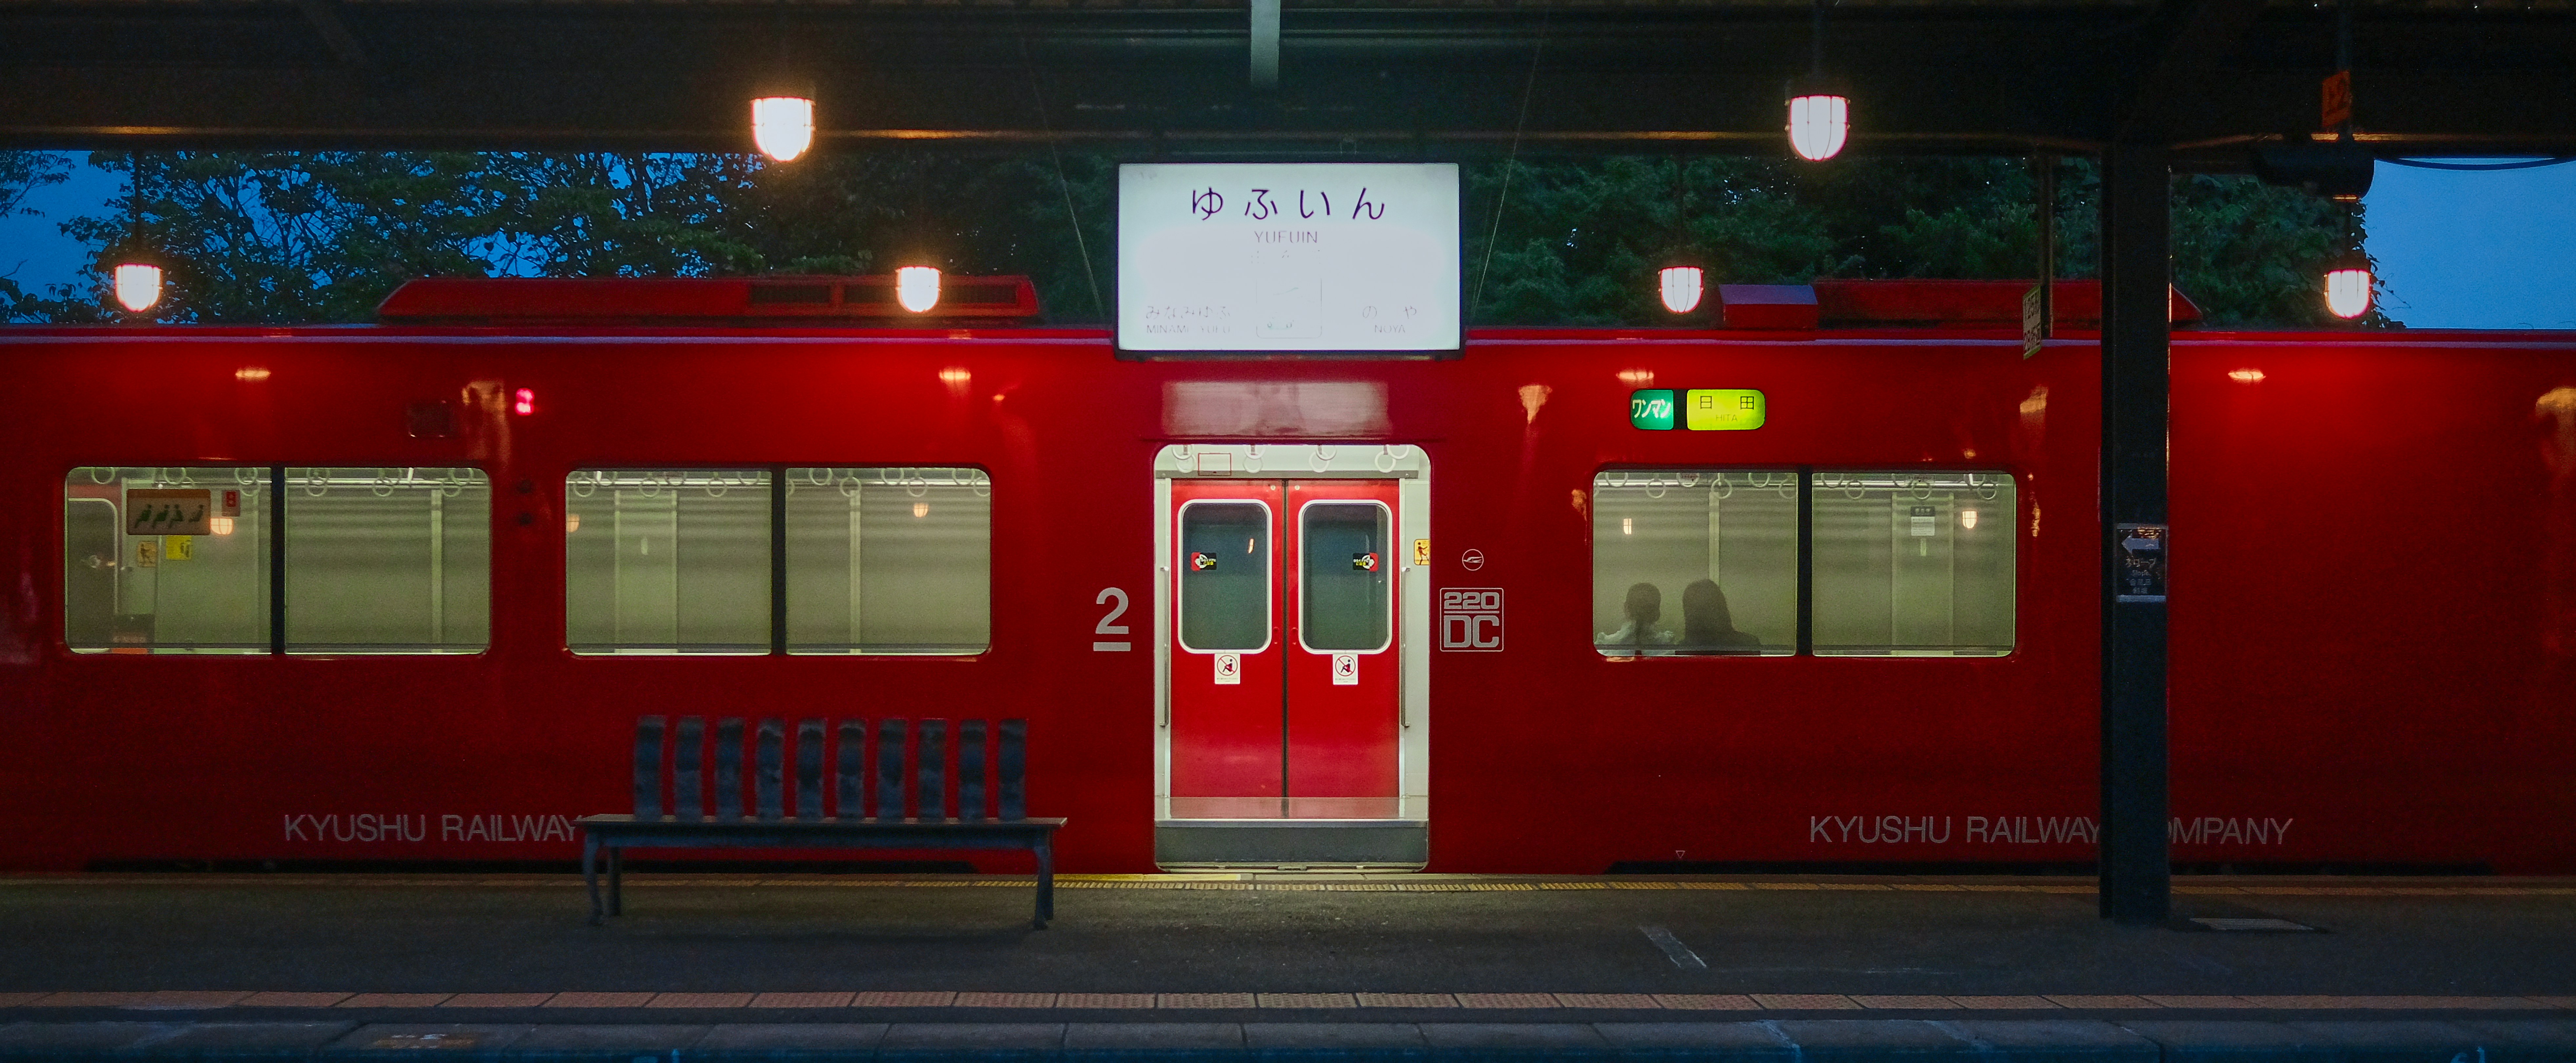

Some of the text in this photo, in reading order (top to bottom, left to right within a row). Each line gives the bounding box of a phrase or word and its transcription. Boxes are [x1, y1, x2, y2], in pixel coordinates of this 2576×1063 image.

[1192, 187, 1384, 221] ゆふいん
[1254, 231, 1317, 243] YUFUIN
[1374, 324, 1405, 333] NOYA
[1632, 399, 1671, 418] ワンマン
[1700, 396, 1754, 410] 日田
[1096, 587, 1129, 634] 2
[1444, 592, 1499, 609] 220
[1444, 615, 1499, 648] DC
[285, 814, 582, 842] KYUSHU RAILWAY
[1810, 815, 1951, 843] KYUSHU
[1967, 816, 2100, 844] RAILWAY
